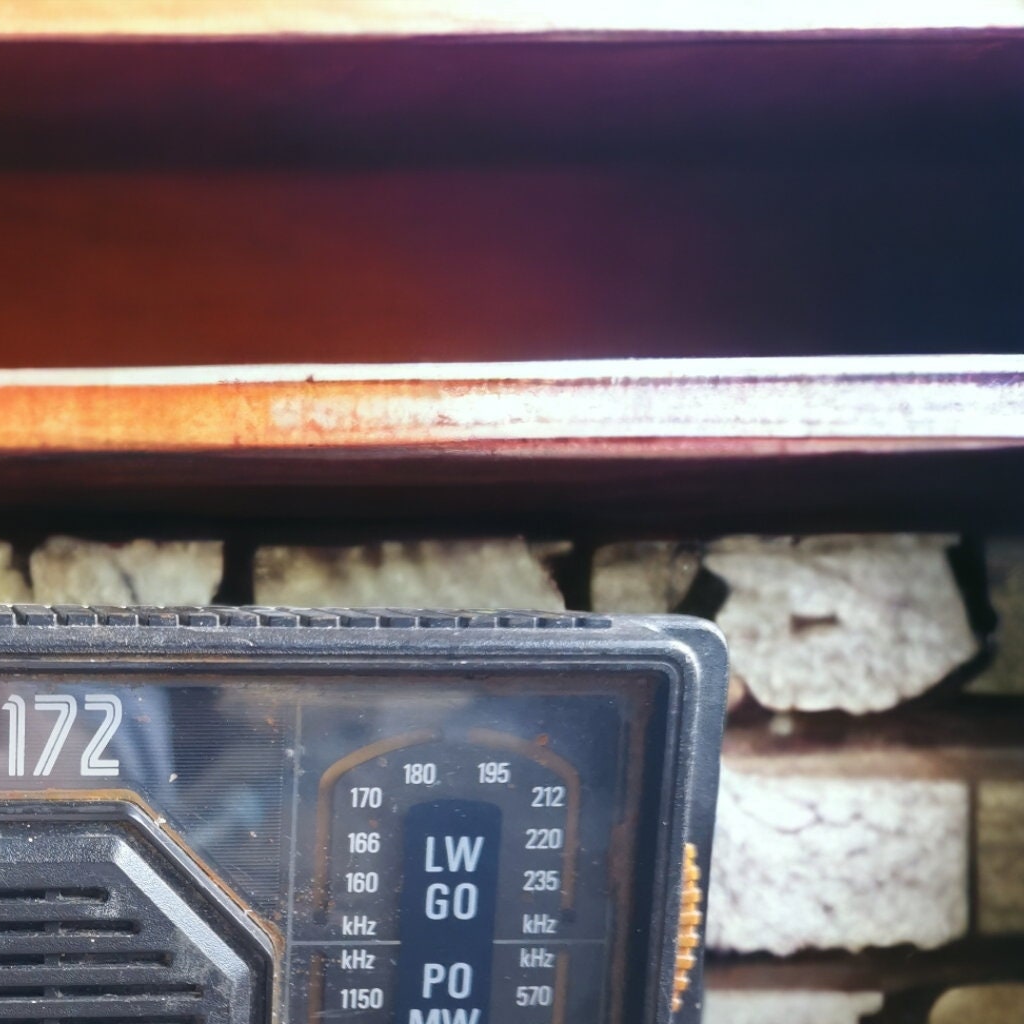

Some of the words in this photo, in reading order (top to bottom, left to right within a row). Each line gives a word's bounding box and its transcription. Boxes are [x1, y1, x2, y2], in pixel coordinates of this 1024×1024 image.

[404, 764, 437, 784] 180
[478, 763, 510, 783] 195
[350, 787, 382, 808] 170
[531, 786, 565, 806] 212
[348, 833, 380, 853] 166
[525, 829, 562, 849] 220
[425, 836, 484, 873] LW
[346, 873, 378, 893] 160
[523, 871, 559, 891] 235
[425, 883, 476, 919] GO
[342, 917, 376, 935] kHz
[523, 915, 557, 934] kHz
[341, 950, 375, 969] kHz
[520, 949, 554, 967] kHz
[422, 963, 472, 999] PO
[341, 989, 383, 1009] 1150
[516, 986, 552, 1006] 570
